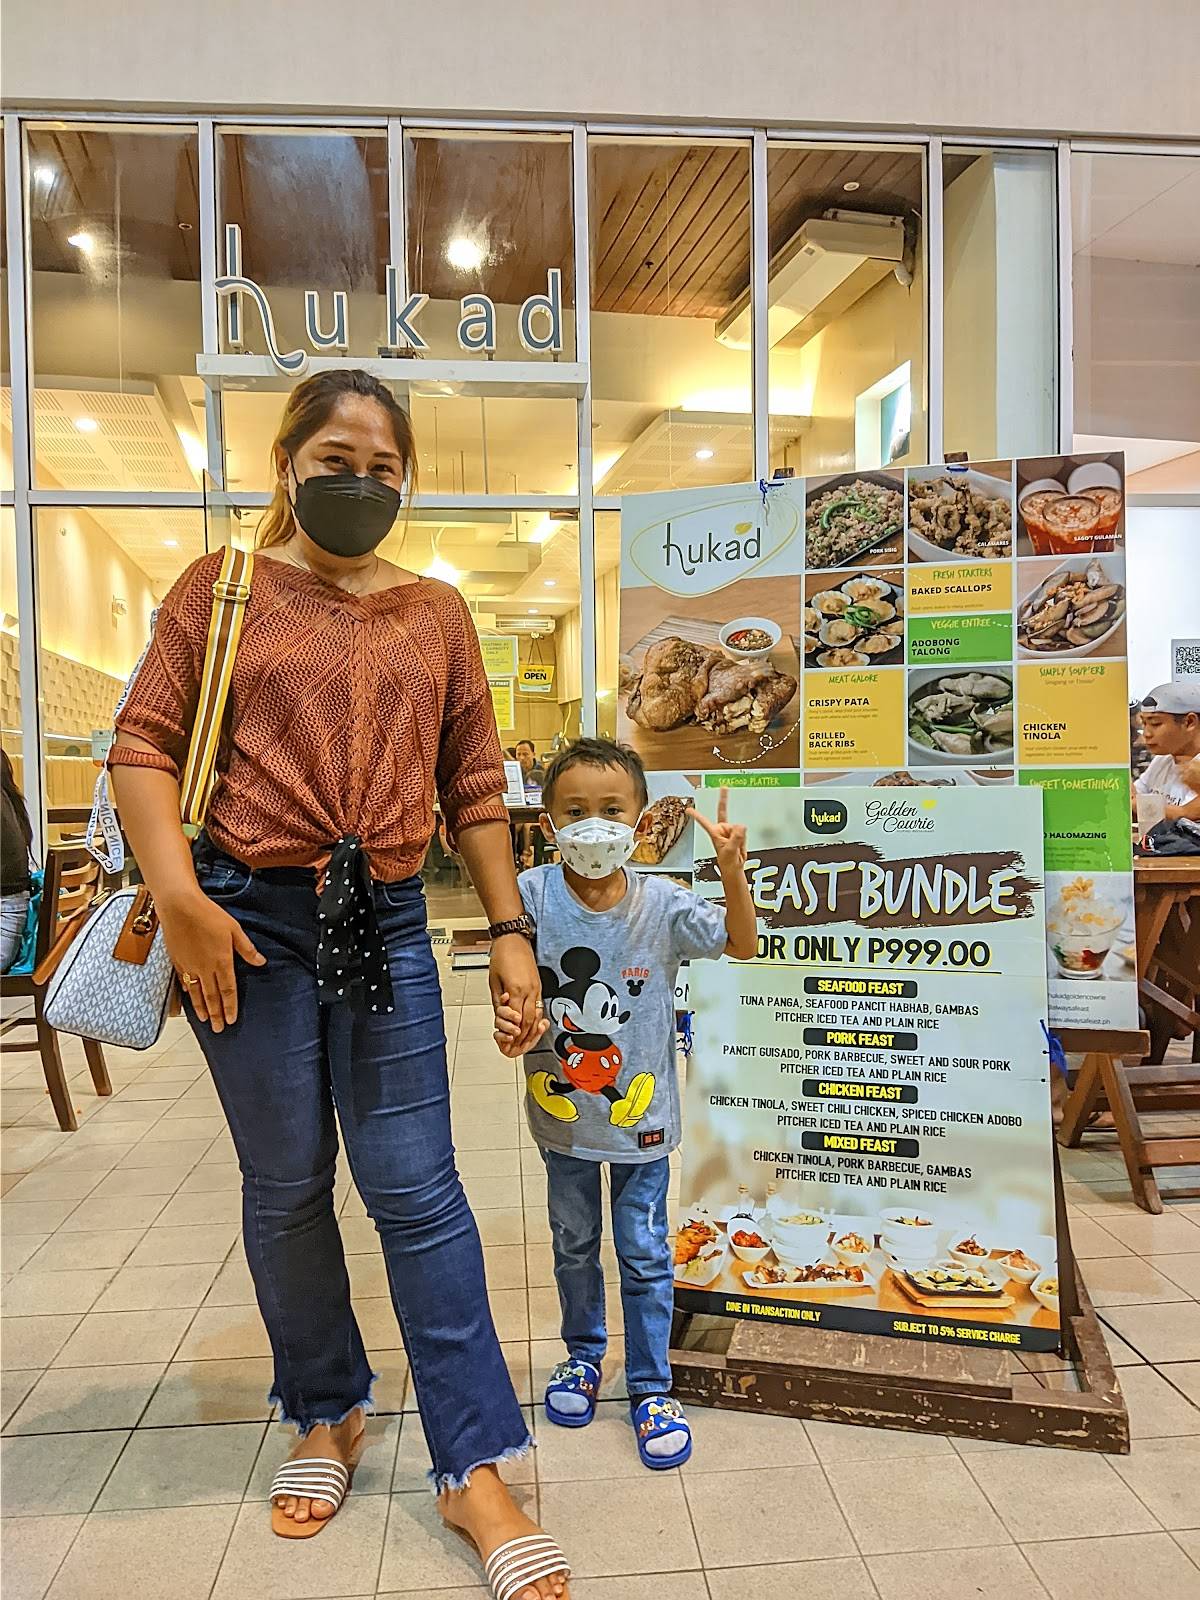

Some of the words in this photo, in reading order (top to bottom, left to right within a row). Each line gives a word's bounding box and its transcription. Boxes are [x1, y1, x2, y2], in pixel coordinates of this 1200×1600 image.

[213, 224, 563, 376] hukad
[662, 522, 760, 575] hukad
[933, 569, 955, 581] FRESH
[956, 567, 993, 579] STARTERS
[911, 586, 942, 595] BAKED
[944, 584, 992, 593] SCALLOPS
[931, 618, 960, 630] VEGGIE
[961, 617, 991, 627] ENTREE
[911, 638, 960, 647] ADOBONG
[911, 647, 950, 656] TALONG
[524, 672, 547, 680] OPEN
[828, 674, 850, 684] MEAT
[850, 674, 878, 683] GALORE
[1039, 666, 1066, 677] SIMPLY
[1069, 666, 1105, 676] SOUP'ERB
[809, 698, 842, 707] CRISPY
[844, 697, 870, 706] PATA
[1023, 723, 1066, 731] CHICKEN
[809, 731, 846, 740] GRILLED
[1023, 732, 1061, 740] TINOLA
[809, 740, 833, 748] BACK
[719, 777, 748, 786] SEAFOOD
[749, 776, 780, 786] PLATTER
[1062, 778, 1119, 790] SOMETHINGS
[811, 806, 841, 826] hukad
[865, 800, 917, 825] Golden
[883, 816, 935, 832] Cowrie
[858, 860, 1019, 921] BUNDLE
[756, 934, 786, 959] OR
[794, 935, 861, 963] ONLY
[868, 938, 991, 967] P999.00
[621, 967, 650, 979] PARIS
[817, 980, 866, 994] SEAFOOD
[868, 982, 904, 995] FEAST
[740, 995, 765, 1006] TUNA
[767, 997, 803, 1009] PANGA,
[805, 998, 849, 1010] SEAFOOD
[851, 1001, 887, 1012] PANCIT
[889, 1003, 932, 1015] HABHAB,
[935, 1005, 979, 1016] GAMBAS
[775, 1012, 814, 1024] PITCHER
[816, 1013, 837, 1024] ICED
[840, 1015, 859, 1026] TEA
[862, 1016, 882, 1027] AND
[885, 1017, 914, 1028] PLAIN
[917, 1019, 940, 1030] RICE
[826, 1031, 856, 1045] PORK
[858, 1033, 895, 1047] FEAST
[723, 1045, 756, 1057] PANCIT
[759, 1047, 803, 1060] GUISADO,
[805, 1049, 831, 1060] PORK
[834, 1051, 887, 1065] BARBECUE,
[890, 1054, 925, 1066] SWEET
[928, 1056, 949, 1067] AND
[952, 1058, 980, 1070] SOUR
[982, 1059, 1011, 1072] PORK
[780, 1063, 819, 1075] PITCHER
[822, 1065, 843, 1076] ICED
[846, 1067, 866, 1078] TEA
[868, 1069, 889, 1079] AND
[891, 1070, 921, 1081] PLAIN
[924, 1071, 947, 1083] RICE
[818, 1082, 865, 1098] CHICKEN
[865, 1085, 902, 1100] FEAST
[710, 1095, 749, 1108] CHICKEN
[752, 1098, 788, 1112] TINOLA,
[791, 1101, 824, 1112] SWEET
[827, 1103, 851, 1115] CHILI
[854, 1104, 899, 1119] CHICKEN,
[901, 1108, 937, 1120] SPICED
[940, 1111, 984, 1124] CHICKEN
[987, 1114, 1022, 1127] ADOBO
[777, 1115, 817, 1128] PITCHER
[820, 1118, 841, 1129] ICED
[843, 1119, 863, 1131] TEA
[866, 1122, 887, 1133] AND
[890, 1123, 920, 1135] PLAIN
[923, 1125, 946, 1137] RICE
[823, 1135, 858, 1150] MIXED
[859, 1137, 897, 1153] FEAST
[753, 1150, 794, 1164] CHICKEN
[796, 1153, 835, 1168] TINOLA,
[837, 1157, 864, 1170] PORK
[867, 1160, 924, 1176] BARBECUE,
[926, 1164, 972, 1178] GAMBAS
[775, 1167, 816, 1181] PITCHER
[819, 1171, 840, 1184] ICED
[843, 1174, 863, 1186] TEA
[866, 1176, 887, 1188] AND
[890, 1177, 921, 1191] PLAIN
[923, 1181, 947, 1193] RICE
[725, 1301, 742, 1312] DINE
[742, 1302, 750, 1313] IN
[751, 1304, 800, 1319] TRANSACTION
[801, 1310, 821, 1322] ONLY
[893, 1320, 927, 1334] SUBJECT
[928, 1324, 939, 1335] TO
[940, 1326, 956, 1337] 5%
[956, 1328, 989, 1340] SERVICE
[989, 1331, 1021, 1344] CHARGE
